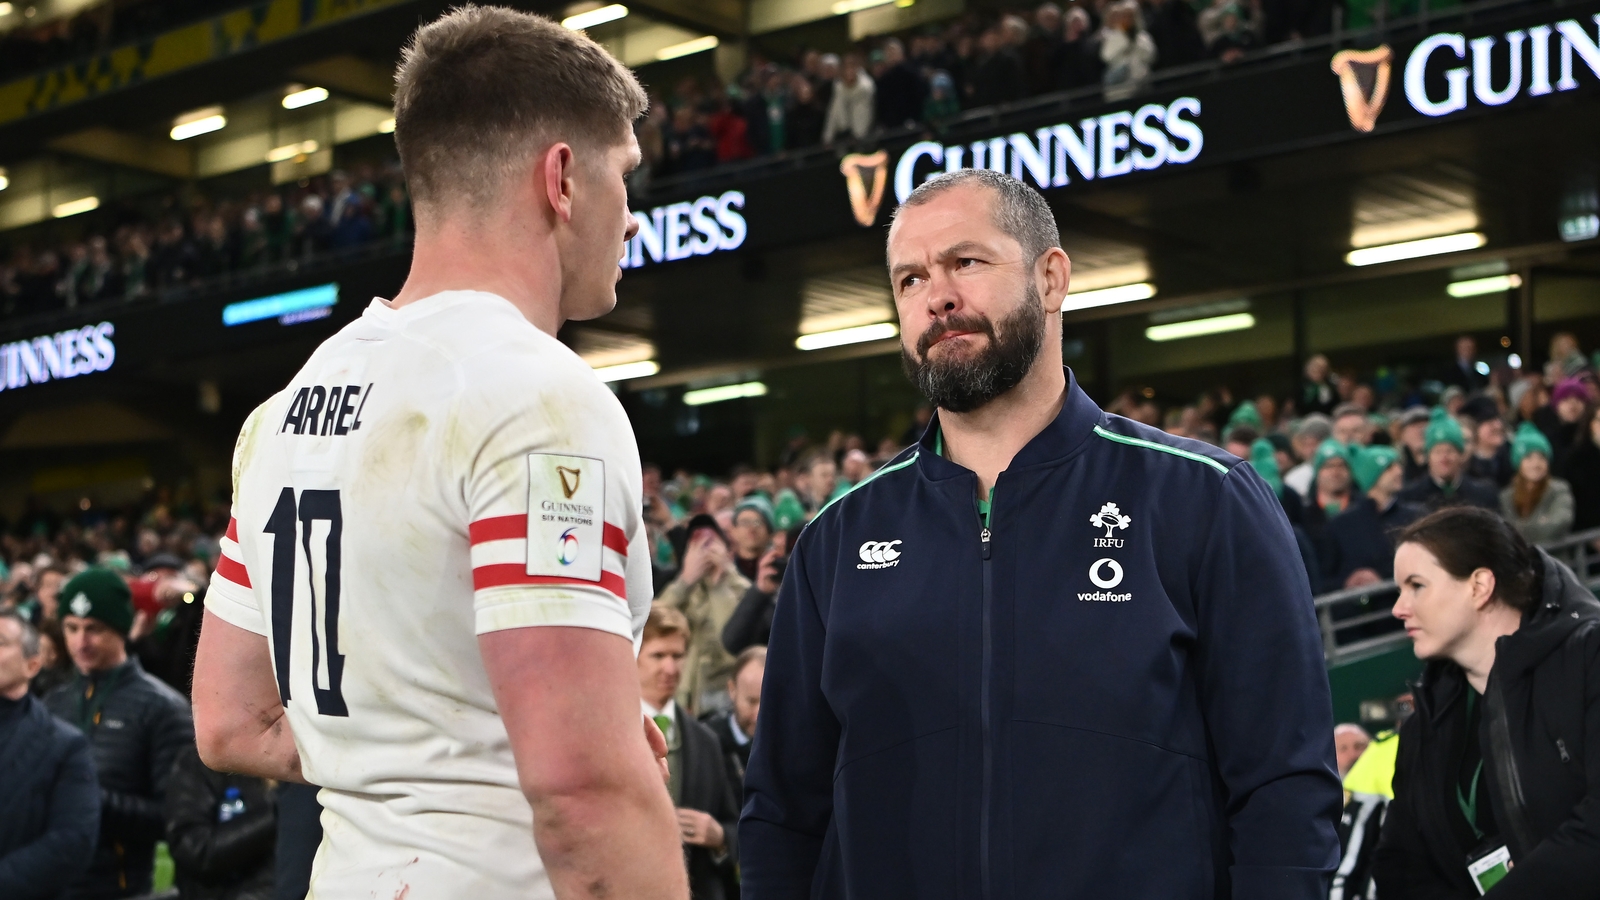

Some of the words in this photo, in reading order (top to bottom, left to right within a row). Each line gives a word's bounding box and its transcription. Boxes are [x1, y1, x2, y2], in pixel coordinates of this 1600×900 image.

[619, 189, 748, 269] NESS
[541, 500, 594, 515] GUINNESS
[541, 514, 556, 522] SIX
[558, 514, 593, 526] NATIONS
[1093, 538, 1125, 549] IRFU
[856, 559, 900, 570] canterbury
[262, 486, 350, 718] 10
[1077, 591, 1132, 602] vodafone
